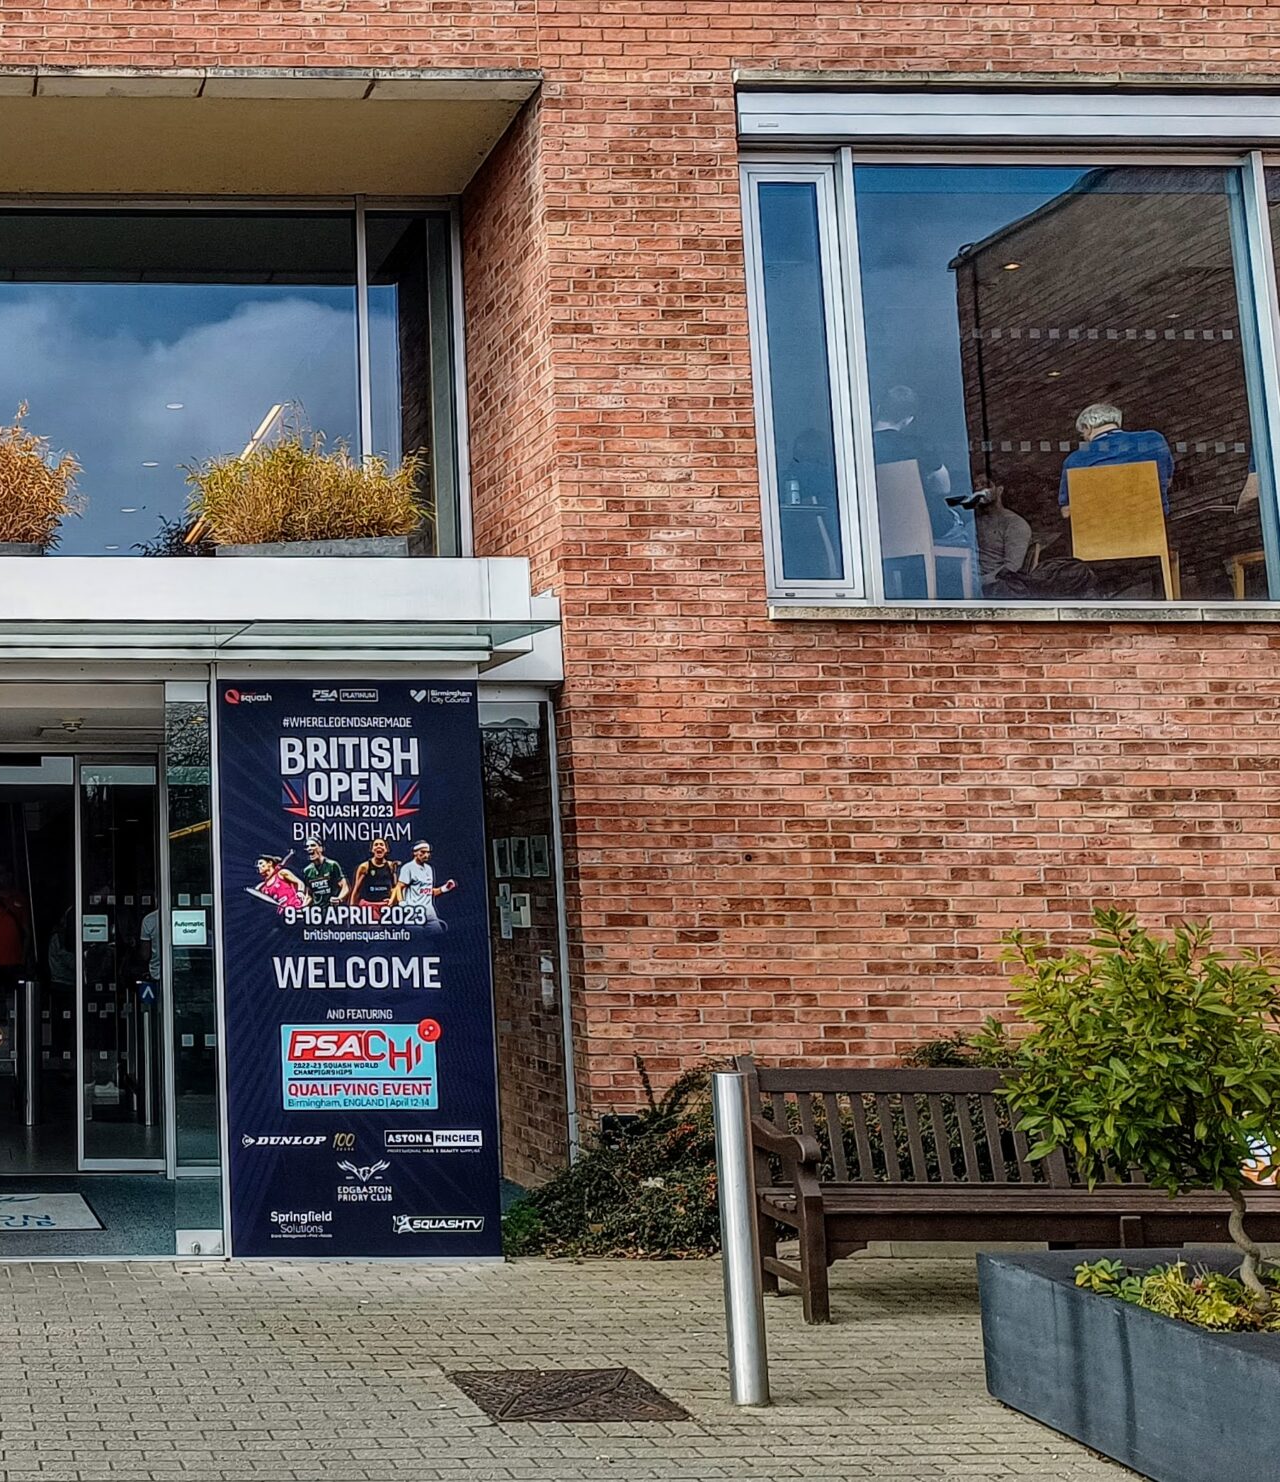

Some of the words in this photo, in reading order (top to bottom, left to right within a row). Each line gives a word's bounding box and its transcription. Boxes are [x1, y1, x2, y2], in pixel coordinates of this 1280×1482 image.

[240, 692, 272, 703] squash
[312, 690, 338, 698] PSA
[431, 690, 472, 698] Birmingham
[431, 697, 443, 705] City
[282, 717, 412, 728] #WHERELEGENDSAREMADE
[280, 737, 419, 775] BRITISH
[307, 772, 394, 802] OPEN
[309, 805, 360, 818] SQUASH
[362, 805, 394, 818] 2023
[293, 823, 411, 842] BIRMINGHAM
[284, 906, 322, 925] 9-16
[325, 906, 378, 925] APRIL
[380, 906, 426, 925] 2023
[304, 930, 410, 942] britishopensquash.info
[272, 957, 441, 989] WELCOME
[327, 1009, 345, 1020] AND
[347, 1009, 393, 1020] FEATURING
[288, 1083, 378, 1097] QUALIFYING
[383, 1083, 432, 1096] EVENT
[343, 1098, 384, 1107] ENGLAND
[389, 1098, 409, 1108] April
[410, 1098, 429, 1107] 12-14
[255, 1136, 326, 1145] DUNLOP
[333, 1133, 355, 1148] 100
[388, 1134, 423, 1143] ASTON
[424, 1134, 432, 1143] &
[435, 1134, 480, 1143] FINCHER
[337, 1186, 392, 1194] EDGBASTON
[337, 1194, 368, 1202] PRIORY
[370, 1194, 393, 1202] CLUB
[270, 1211, 332, 1224] Springfield
[280, 1223, 324, 1233] Solutions
[411, 1219, 482, 1229] SQUASHTV
